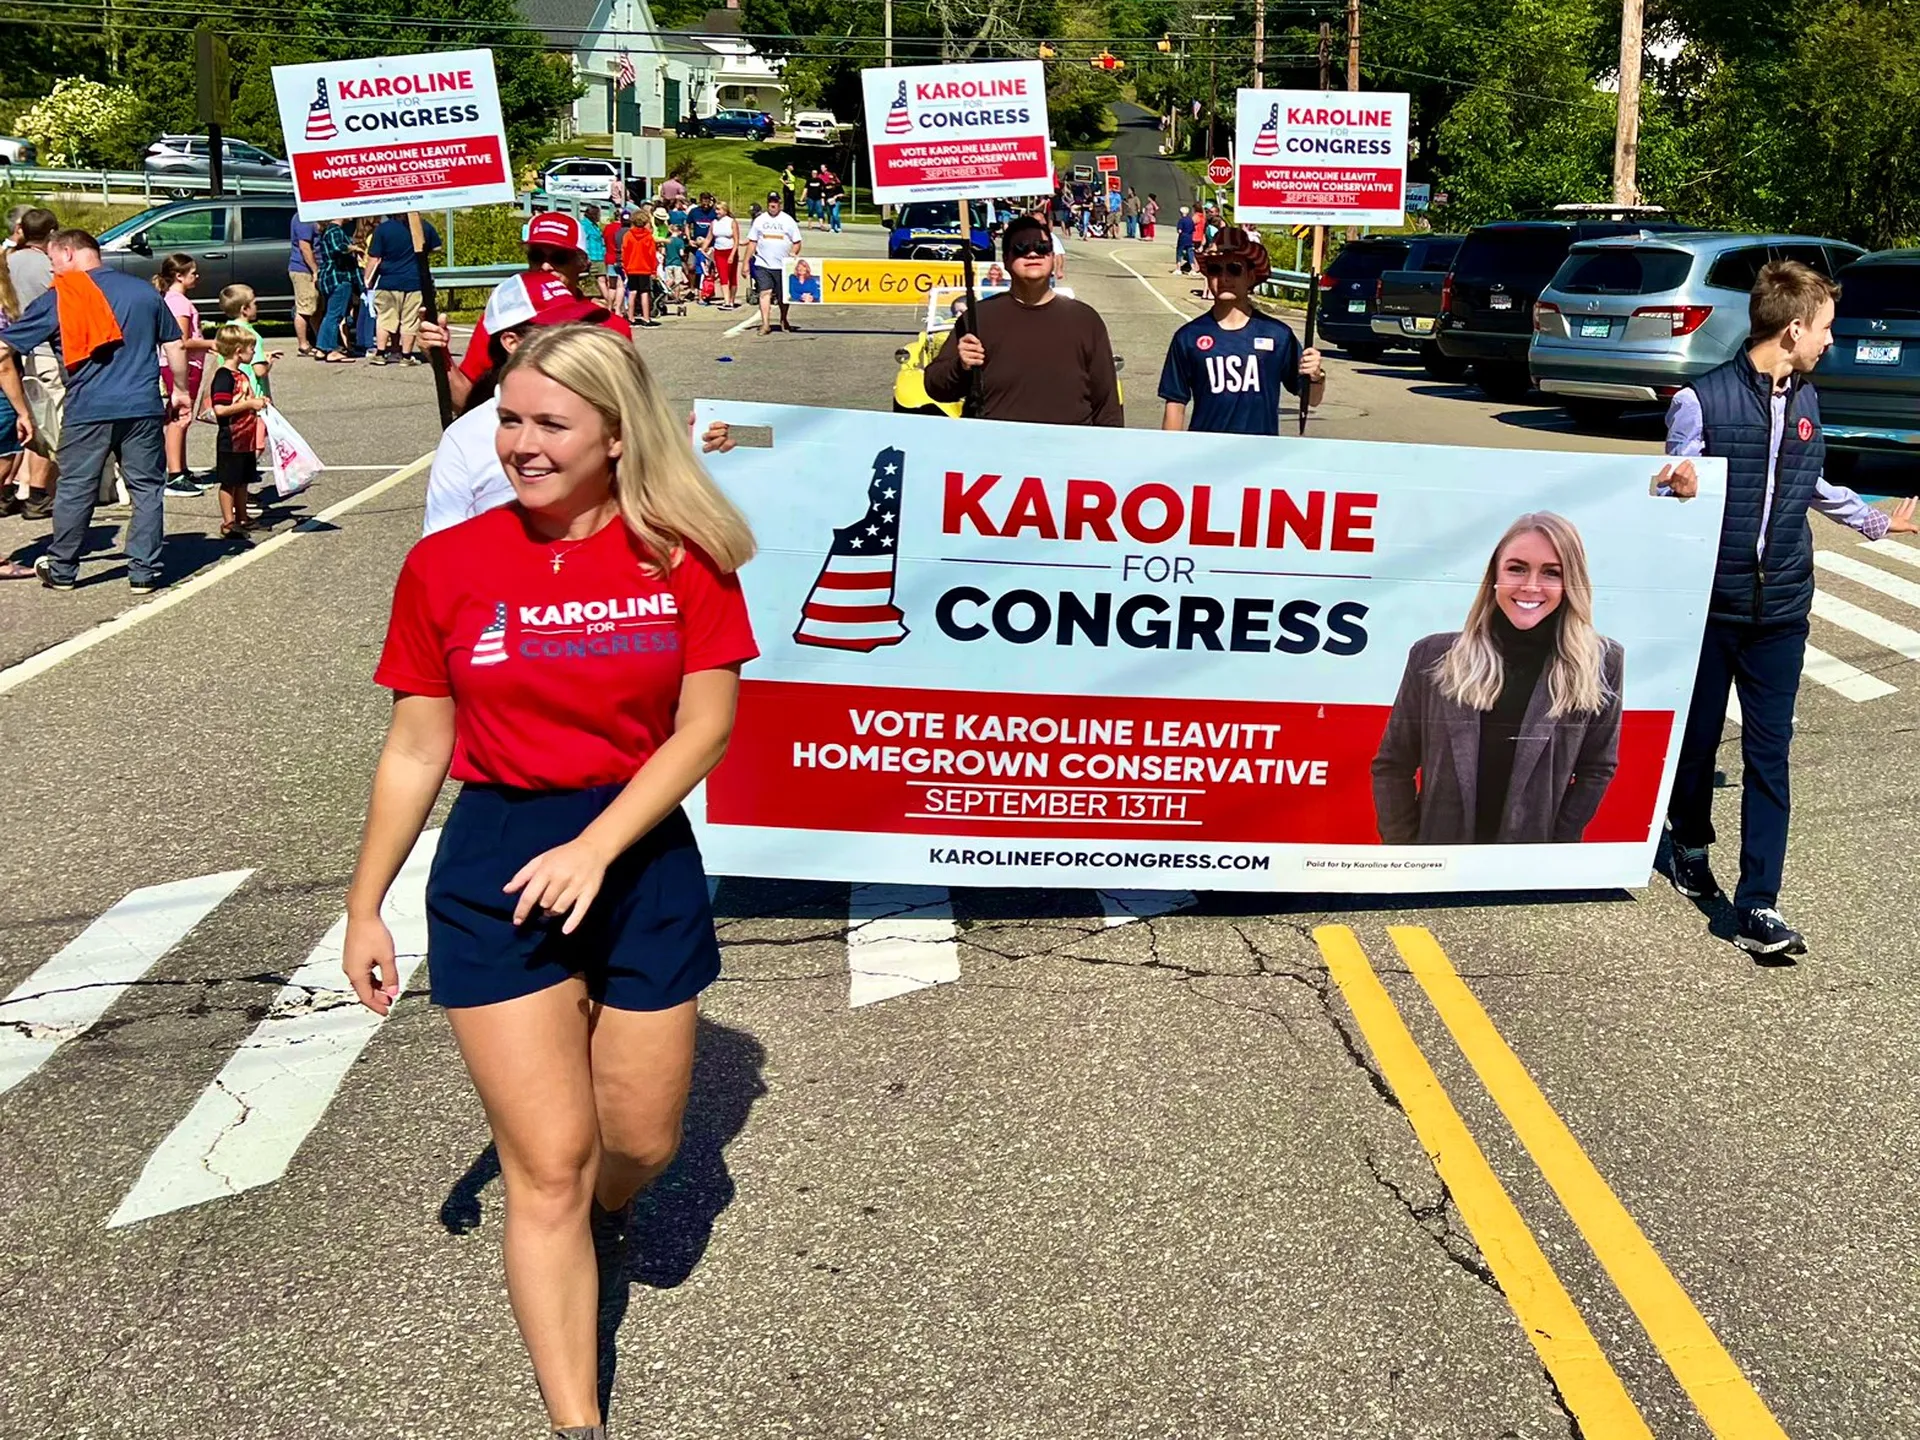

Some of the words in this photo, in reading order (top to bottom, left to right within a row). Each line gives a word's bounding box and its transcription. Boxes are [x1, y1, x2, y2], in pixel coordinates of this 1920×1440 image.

[338, 70, 474, 100] KAROLINE
[916, 79, 1027, 100] KAROLINE
[397, 96, 421, 108] FOR
[963, 100, 983, 109] FOR
[345, 104, 480, 132] CONGRESS
[919, 108, 1030, 128] CONGRESS
[1287, 108, 1392, 127] KAROLINE
[1330, 128, 1349, 137] FOR
[326, 154, 358, 166] VOTE
[360, 149, 419, 163] KAROLINE
[420, 144, 467, 158] LEAVITT
[901, 148, 928, 157] VOTE
[929, 144, 978, 155] KAROLINE
[980, 142, 1019, 152] LEAVITT
[1286, 138, 1391, 155] CONGRESS
[312, 164, 398, 180] HOMEGROWN
[400, 153, 492, 172] CONSERVATIVE
[888, 156, 960, 168] HOMEGROWN
[961, 152, 1038, 165] CONSERVATIVE
[358, 175, 419, 190] SEPTEMBER
[420, 172, 446, 184] 13TH
[926, 168, 977, 178] SEPTEMBER
[1209, 165, 1232, 177] STOP
[1265, 170, 1291, 180] VOTE
[1292, 170, 1339, 181] KAROLINE
[1341, 171, 1377, 181] LEAVITT
[1252, 179, 1320, 191] HOMEGROWN
[1322, 181, 1394, 193] CONSERVATIVE
[1285, 193, 1335, 203] SEPTEMBER
[827, 273, 870, 293] You
[879, 273, 908, 293] Go
[1205, 354, 1260, 394] USA
[942, 471, 1379, 553] KAROLINE
[1122, 555, 1195, 584] FOR
[519, 593, 678, 626] KAROLINE
[586, 622, 616, 635] FOR
[935, 586, 1370, 656] CONGRESS
[520, 632, 679, 660] CONGRESS
[849, 709, 945, 740] VOTE
[955, 713, 1134, 747] KAROLINE
[1144, 720, 1281, 750] LEAVITT
[793, 742, 1049, 779] HOMEGROWN
[1059, 752, 1329, 786] CONSERVATIVE
[925, 788, 1108, 817] SEPTEMBER
[1117, 794, 1188, 818] 13TH
[929, 848, 1270, 871] KAROLINEFORCONGRESS.COM
[1305, 860, 1325, 868] Paid
[1341, 861, 1352, 869] by
[1353, 861, 1389, 869] Karoline
[1390, 861, 1402, 869] for
[1404, 861, 1443, 870] Congress
